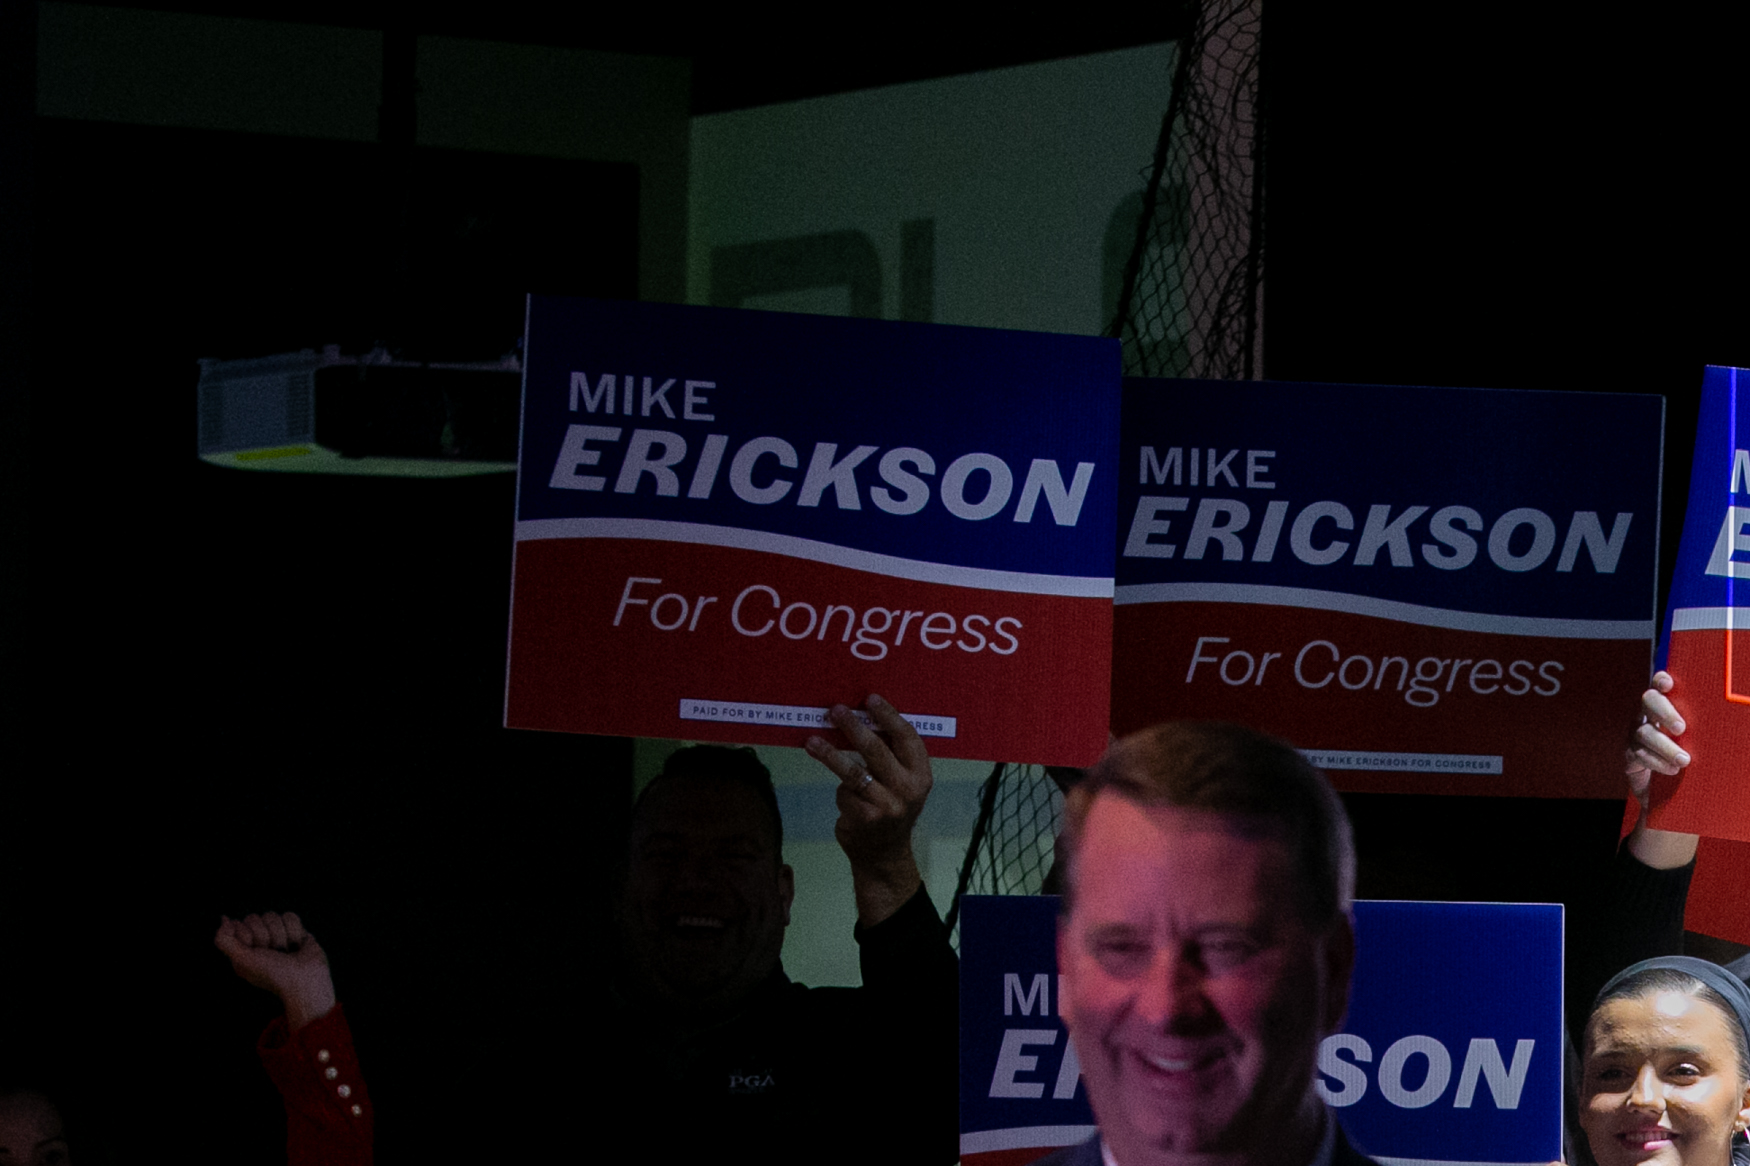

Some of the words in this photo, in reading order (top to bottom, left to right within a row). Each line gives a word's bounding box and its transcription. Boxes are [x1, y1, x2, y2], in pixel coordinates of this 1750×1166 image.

[570, 372, 715, 421] MIKE
[549, 424, 1096, 527] ERICKSON
[1140, 447, 1275, 488] MIKE
[1124, 496, 1632, 572] ERICKSON
[614, 577, 717, 631] For
[732, 585, 1022, 660] Congress
[1186, 637, 1281, 685] For
[1294, 640, 1564, 707] Congress
[692, 706, 718, 716] PAID
[722, 708, 744, 717] FOR
[748, 710, 762, 719] BY
[766, 712, 792, 720] MIKE
[797, 713, 832, 723] ERICK
[1327, 756, 1352, 765] MIKE
[1355, 758, 1408, 767] ERICKSON
[1411, 759, 1431, 767] FOR
[1435, 760, 1491, 769] CONGRESS
[728, 1074, 776, 1088] PGA
